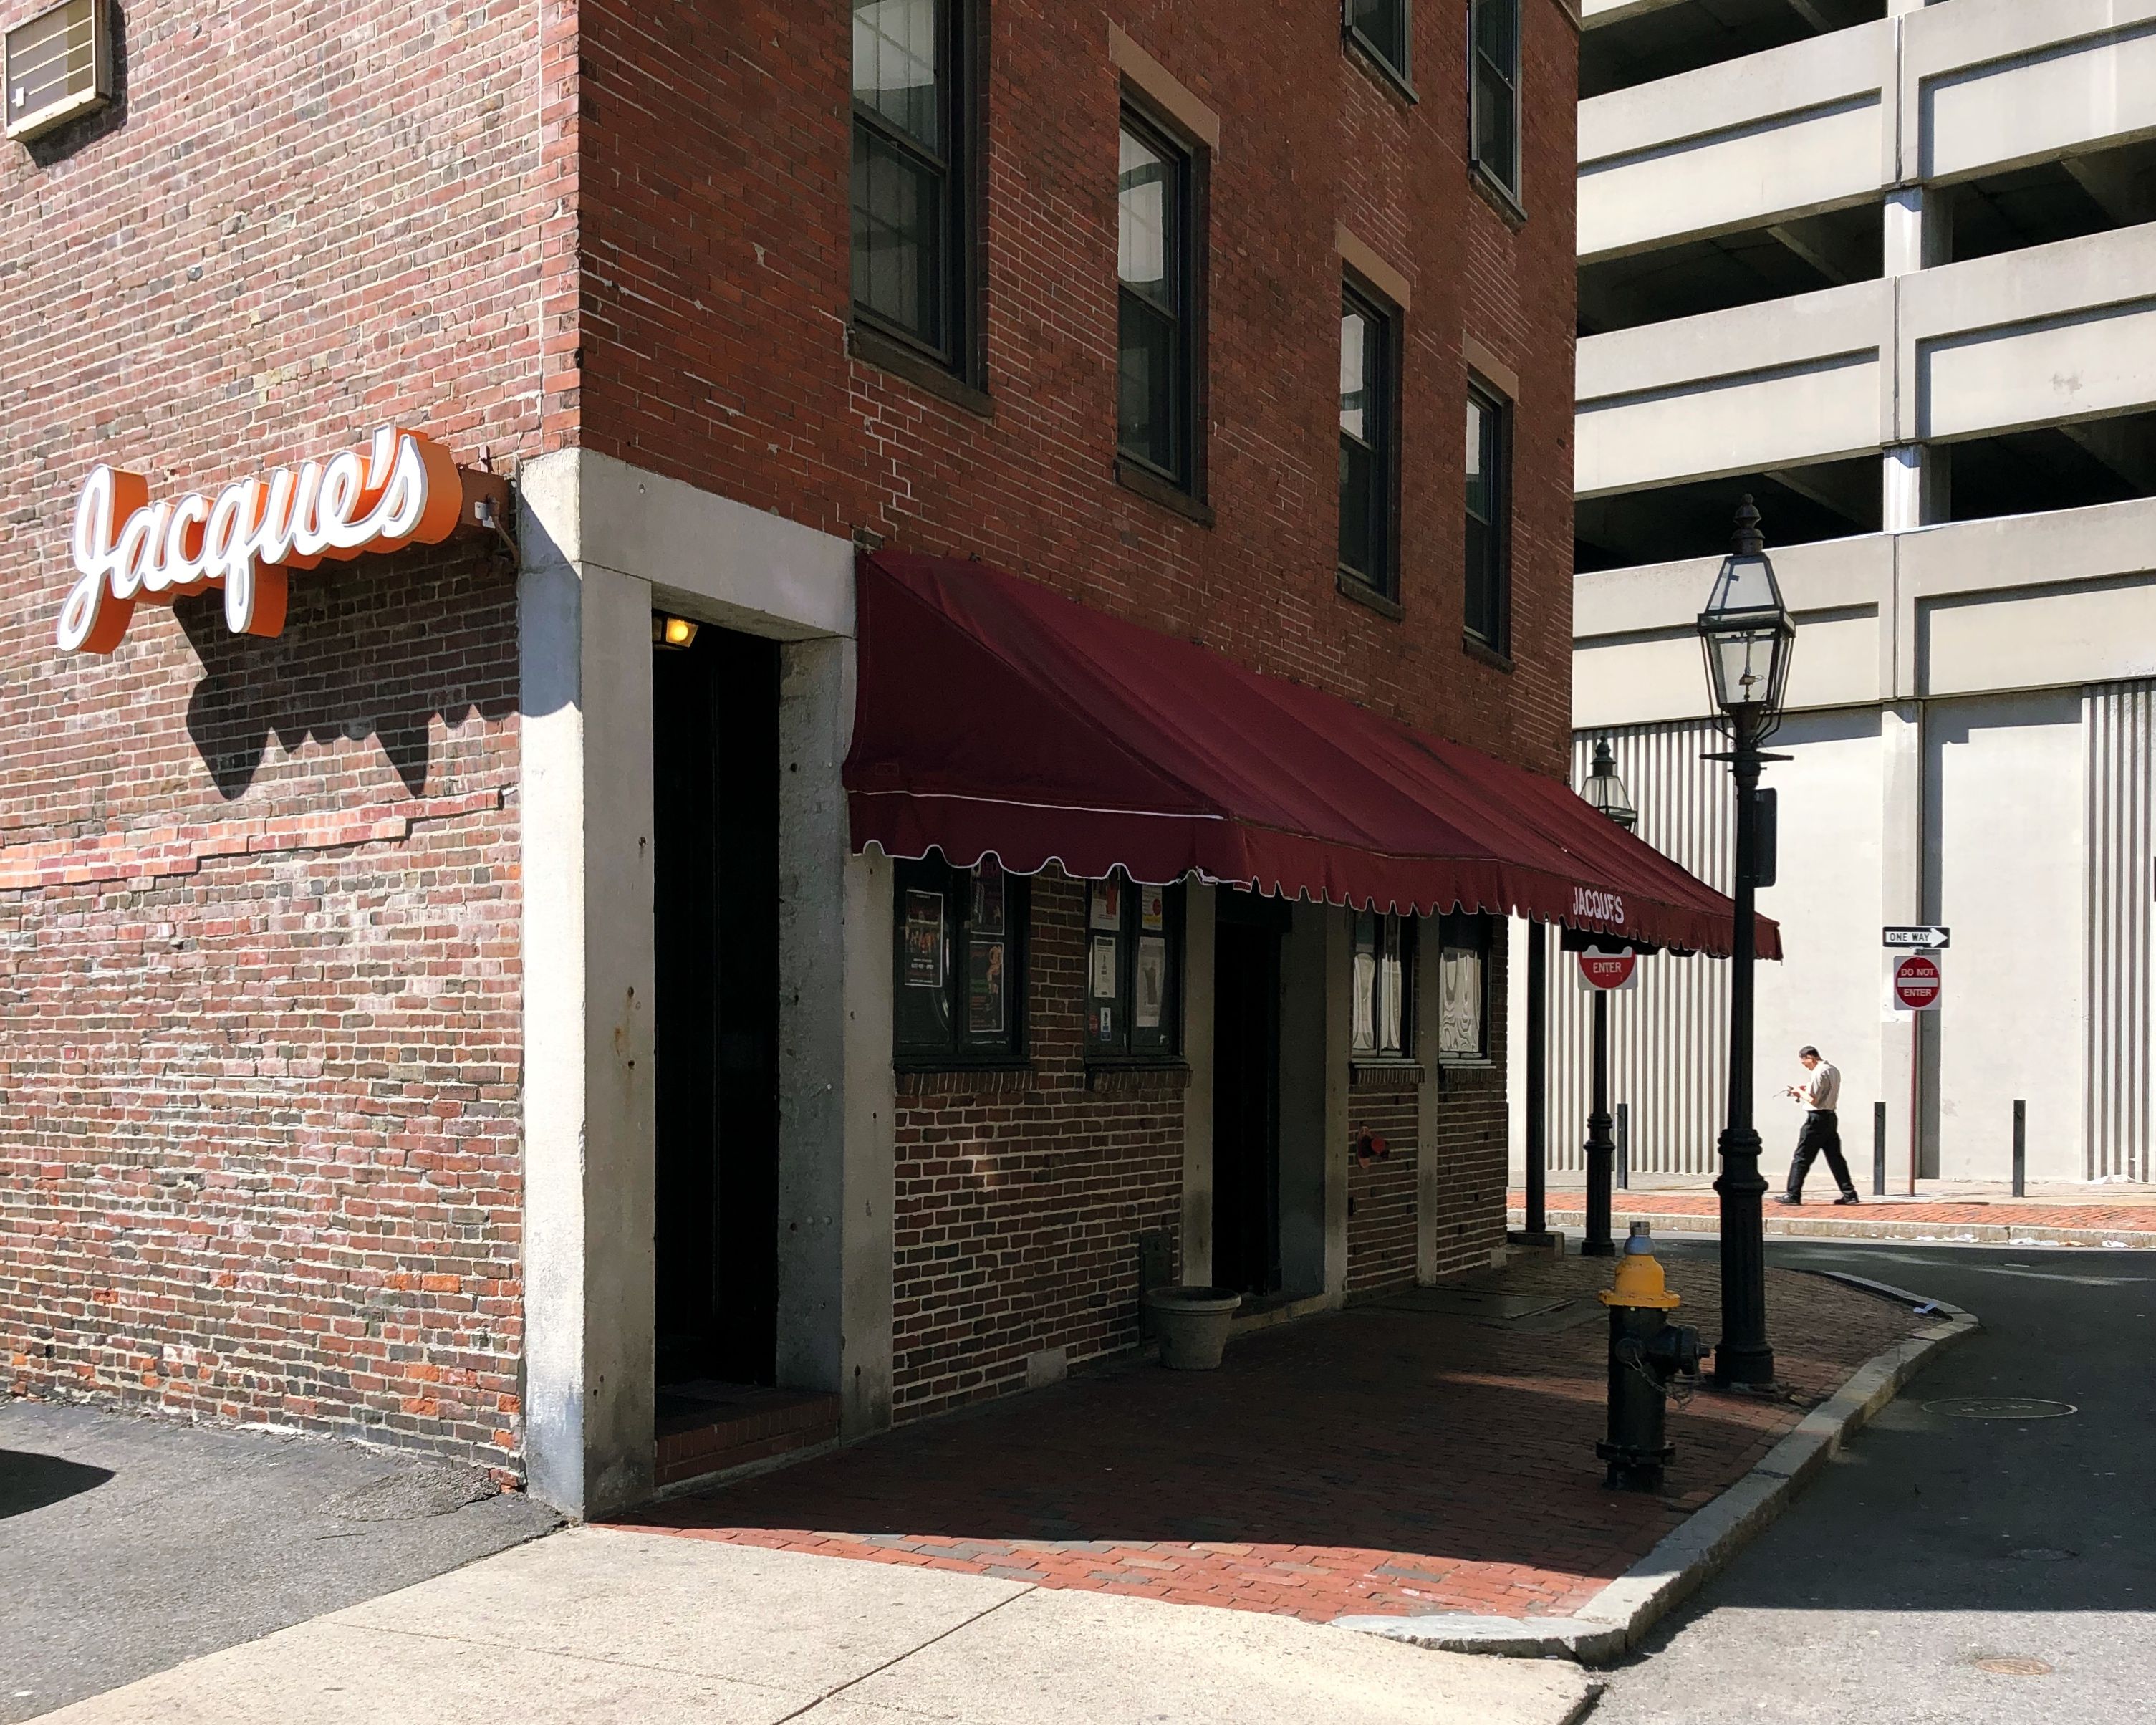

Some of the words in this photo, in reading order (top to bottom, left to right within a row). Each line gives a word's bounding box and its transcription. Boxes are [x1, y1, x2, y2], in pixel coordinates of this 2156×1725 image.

[57, 424, 429, 652] Jacque's
[1890, 933, 1907, 941] ONE
[1912, 933, 1930, 941] WAY
[1593, 962, 1622, 973] ENTER
